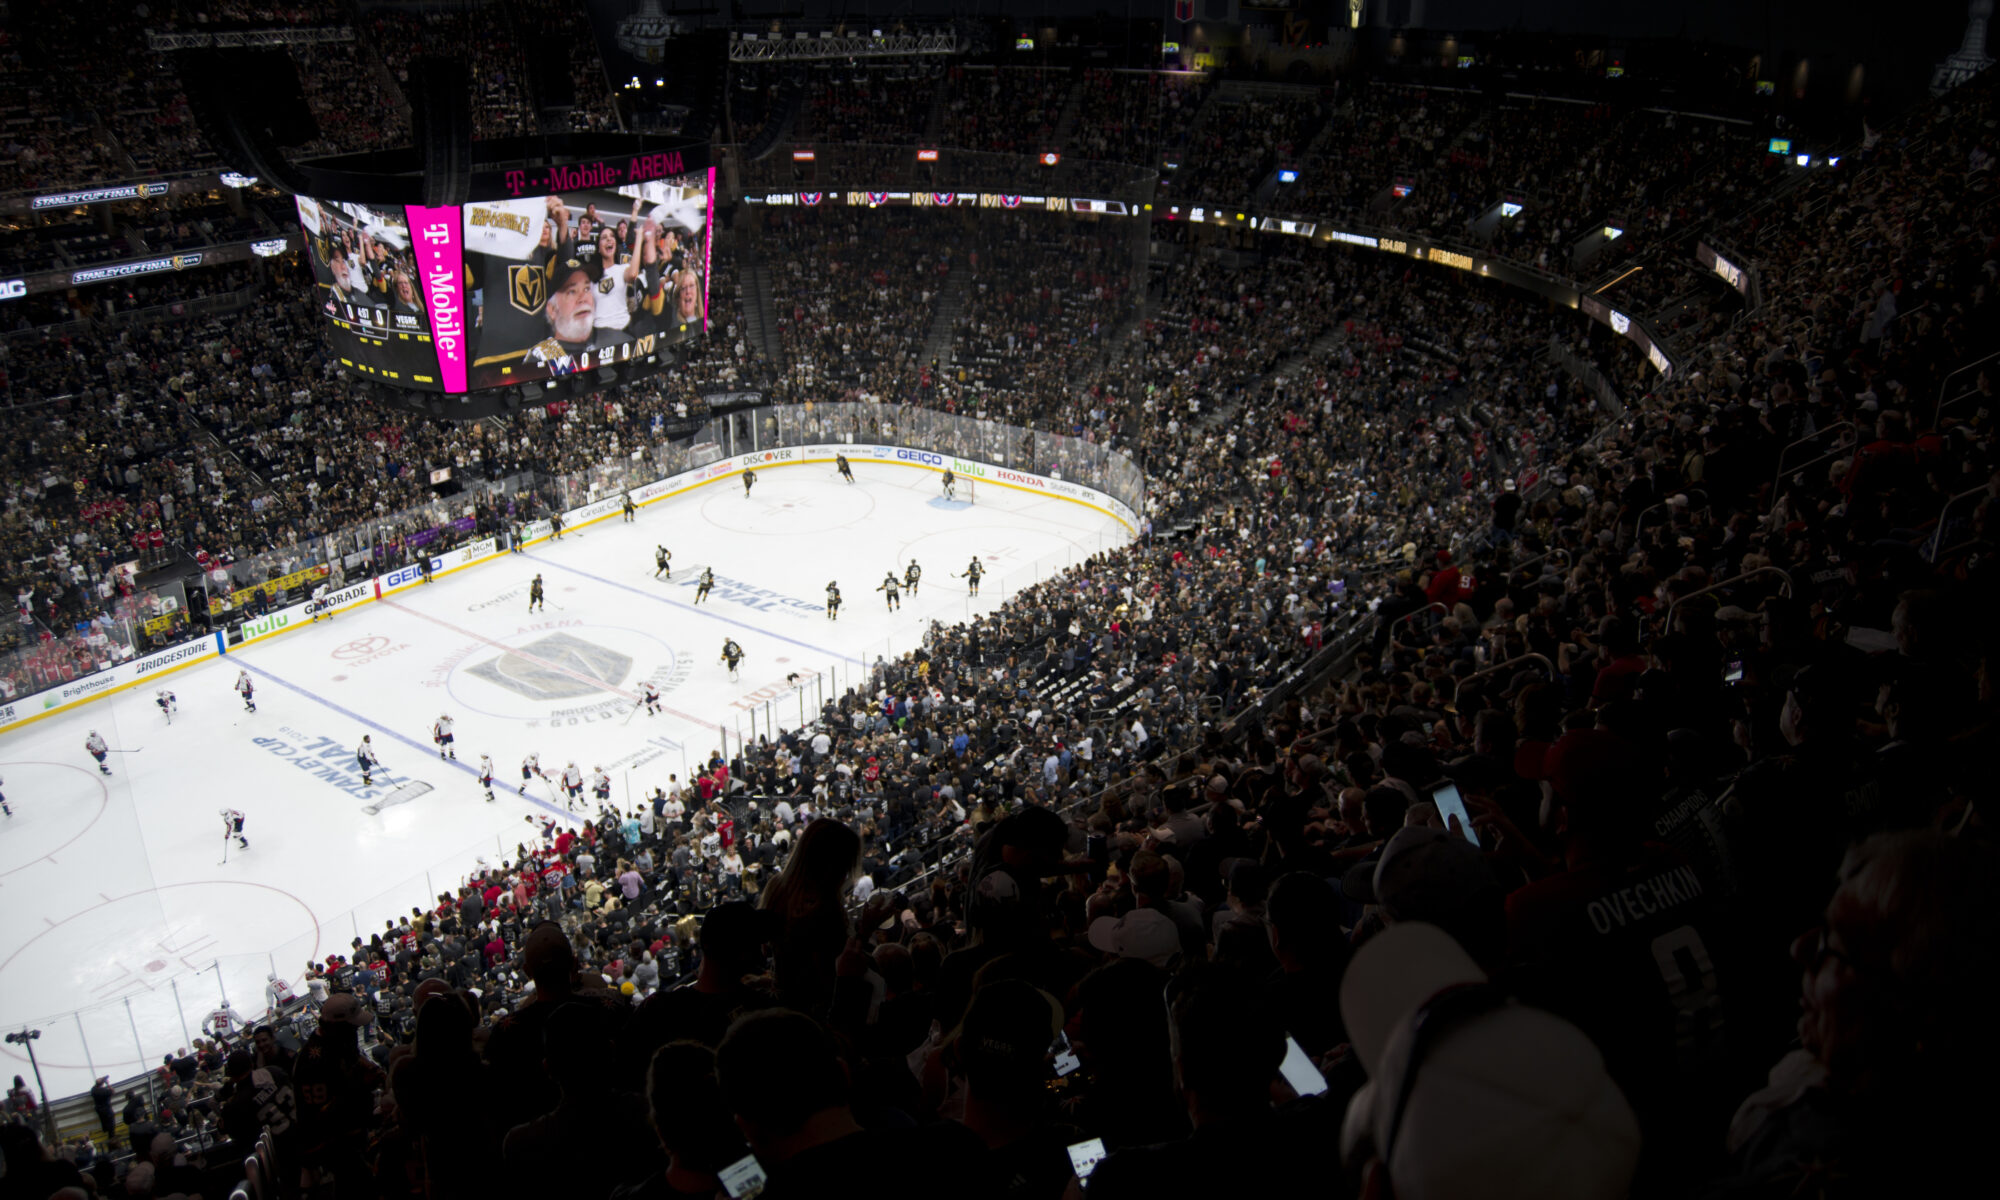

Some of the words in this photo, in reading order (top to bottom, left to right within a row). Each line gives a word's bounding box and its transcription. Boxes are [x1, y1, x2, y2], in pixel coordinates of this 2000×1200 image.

[628, 151, 685, 181] ARENA
[36, 194, 80, 207] STANLEY
[82, 191, 103, 201] CUP
[104, 188, 137, 198] FINAL
[766, 195, 781, 204] 4:53
[783, 195, 793, 204] PM
[75, 268, 119, 282] STANLEY
[120, 265, 140, 275] CUP
[140, 260, 172, 272] FINAL
[581, 352, 589, 369] 0
[599, 346, 615, 359] 4:07
[622, 342, 630, 359] 0
[743, 449, 792, 466] DISCOVER
[897, 449, 942, 465] GEICO
[953, 459, 985, 477] hulu
[997, 470, 1045, 488] HONDA
[580, 504, 606, 519] Great
[473, 541, 493, 552] MGM
[304, 585, 367, 615] GORADE
[779, 597, 826, 612] CUP
[241, 613, 289, 640] hulu
[516, 618, 584, 634] ARENA
[136, 641, 208, 675] BRIDGESTONE
[345, 642, 412, 667] TOYOTA
[63, 676, 115, 698] Brighthouse
[251, 736, 298, 757] CUP
[285, 755, 383, 800] STANLEY
[1655, 789, 1709, 837] CHAMPIONS
[1587, 864, 1703, 935] OVECHKIN
[215, 1016, 228, 1028] 25
